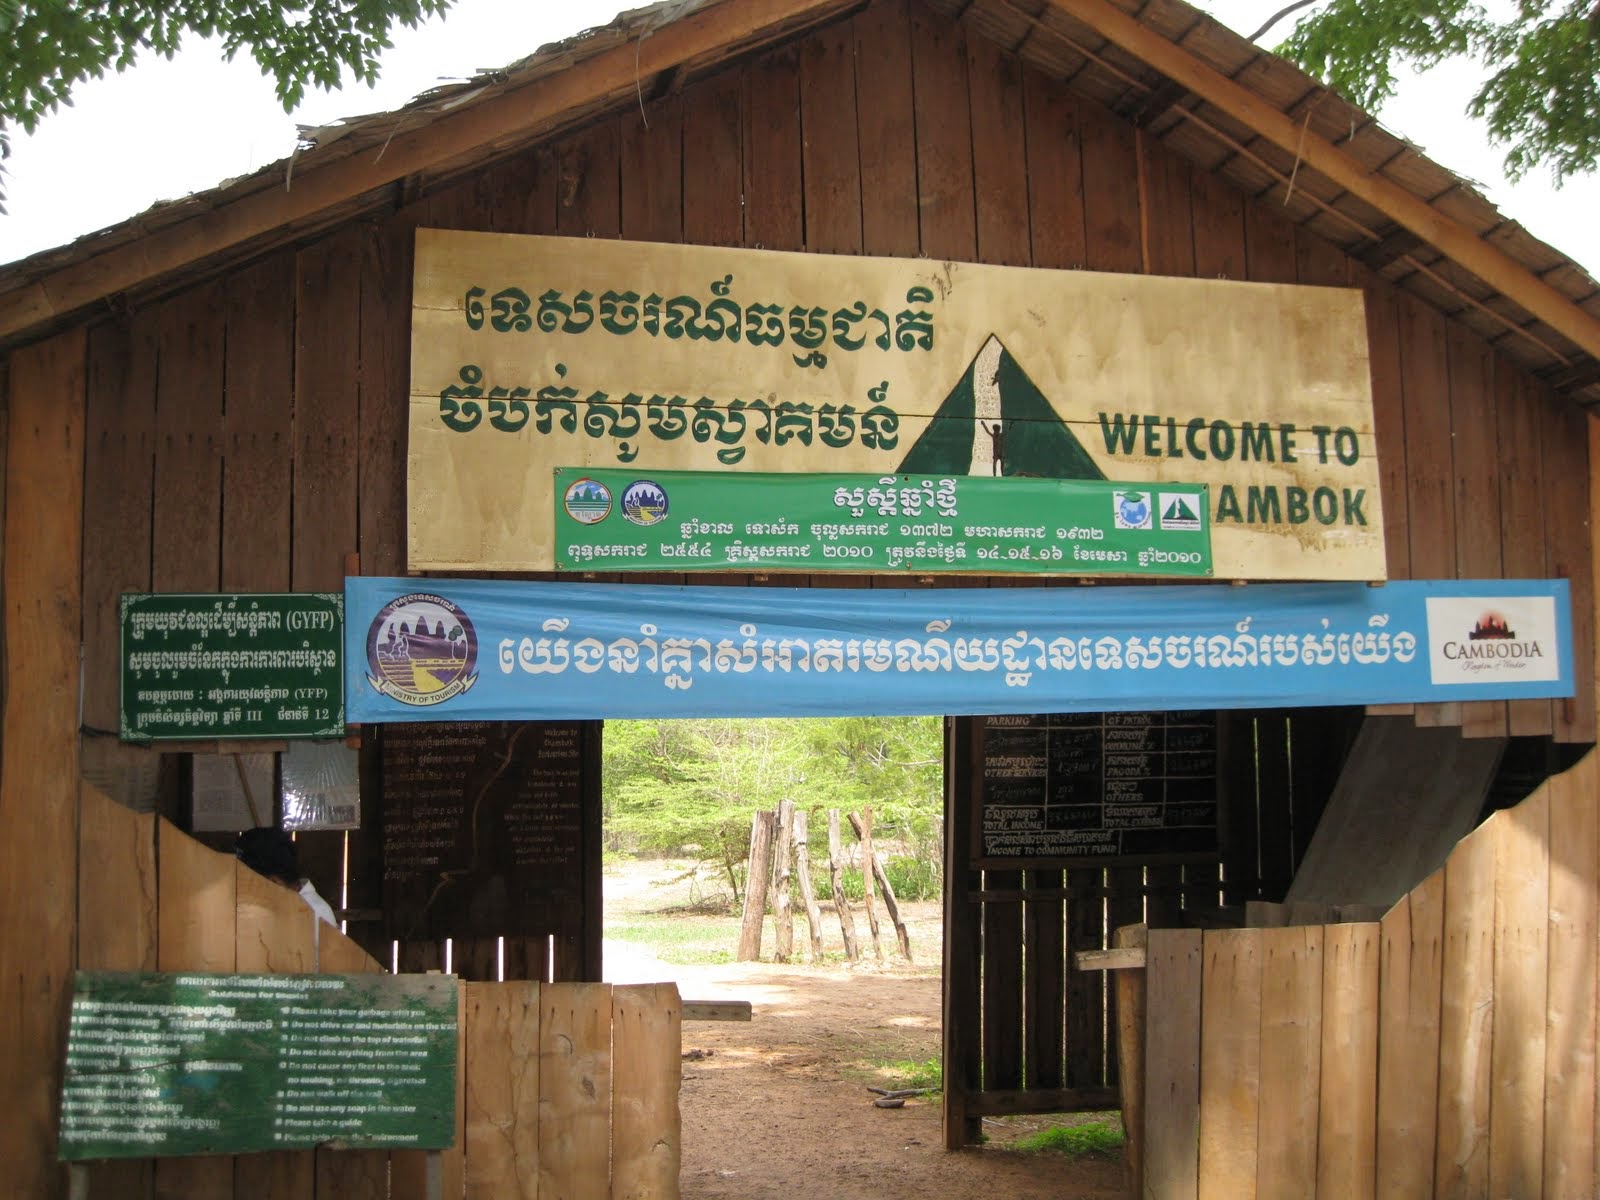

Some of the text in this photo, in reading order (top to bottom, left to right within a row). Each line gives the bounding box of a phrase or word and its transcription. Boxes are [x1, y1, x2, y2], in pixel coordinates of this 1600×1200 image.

[464, 274, 935, 369] ទេសចរណ៍ធម្មជាតិ
[439, 363, 900, 465] ចំបក់សូមស្វាគមន៍
[1098, 412, 1360, 467] WELCOME TO
[900, 524, 953, 538] ១៣៧២
[964, 525, 1046, 539] មហាសករាជ
[1056, 527, 1104, 541] ១៩៣២
[660, 543, 712, 558] ២៥៥៤
[823, 545, 874, 558] ២០១០
[1074, 544, 1128, 562] ខែមេសា
[286, 610, 334, 632] (GYFP)
[1443, 640, 1543, 659] CAMBODIA
[294, 688, 328, 700] (YFP)
[384, 681, 417, 702] MINISTRY
[431, 683, 461, 702] TOURISM
[314, 709, 329, 720] 12
[987, 716, 1030, 726] PARKING
[1106, 793, 1144, 801] OTHERS
[983, 821, 1010, 830] TOTAL
[987, 847, 1021, 857] INCOME
[1024, 847, 1035, 856] TO
[338, 1008, 357, 1017] your
[410, 1010, 425, 1018] you
[320, 1021, 341, 1029] drive
[290, 1048, 301, 1056] Do
[337, 1049, 373, 1059] anything
[375, 1049, 394, 1057] from
[301, 1062, 317, 1070] not
[377, 1062, 385, 1070] in
[286, 1104, 298, 1112] Do
[299, 1104, 314, 1112] not
[330, 1105, 346, 1114] any
[347, 1105, 366, 1114] soap
[368, 1104, 376, 1112] in
[377, 1104, 392, 1112] the
[339, 1118, 362, 1128] guide
